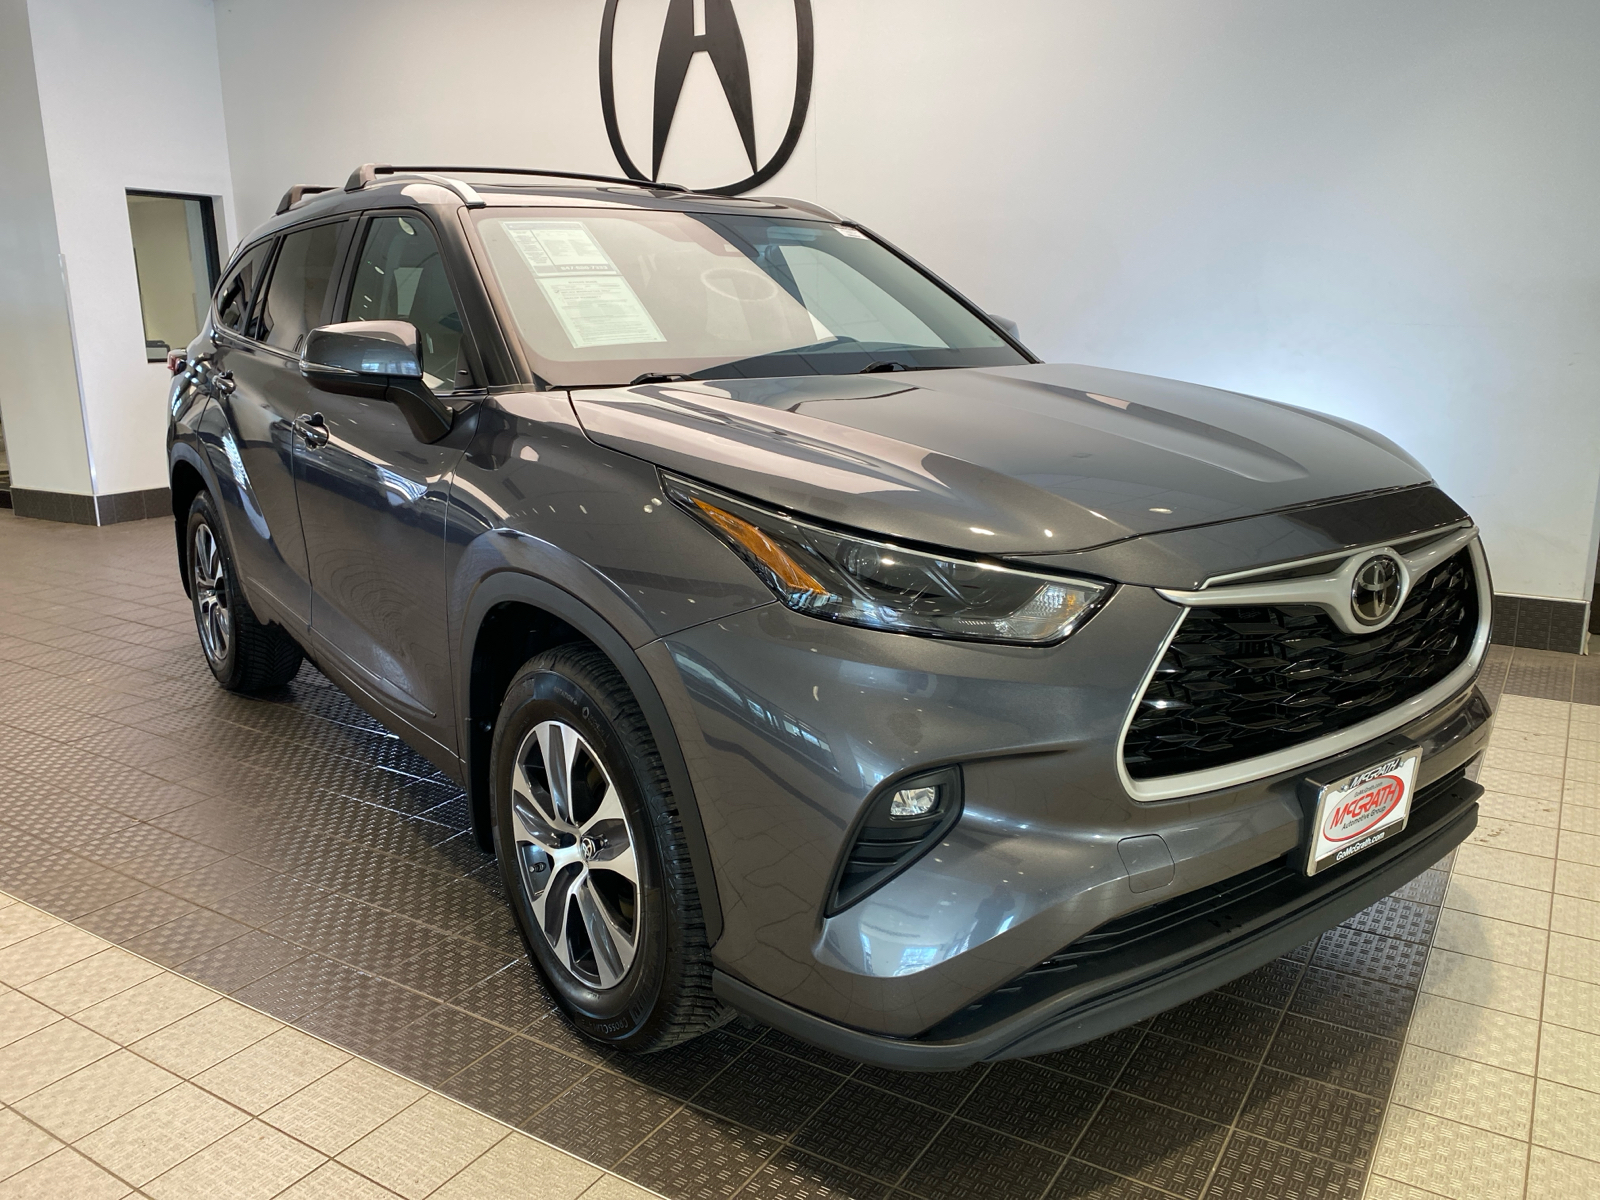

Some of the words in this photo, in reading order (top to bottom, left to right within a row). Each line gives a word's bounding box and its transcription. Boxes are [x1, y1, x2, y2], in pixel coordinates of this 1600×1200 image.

[1341, 813, 1371, 831] Automotive
[1370, 806, 1387, 817] Group
[1336, 832, 1385, 861] GoMcGrath.com
